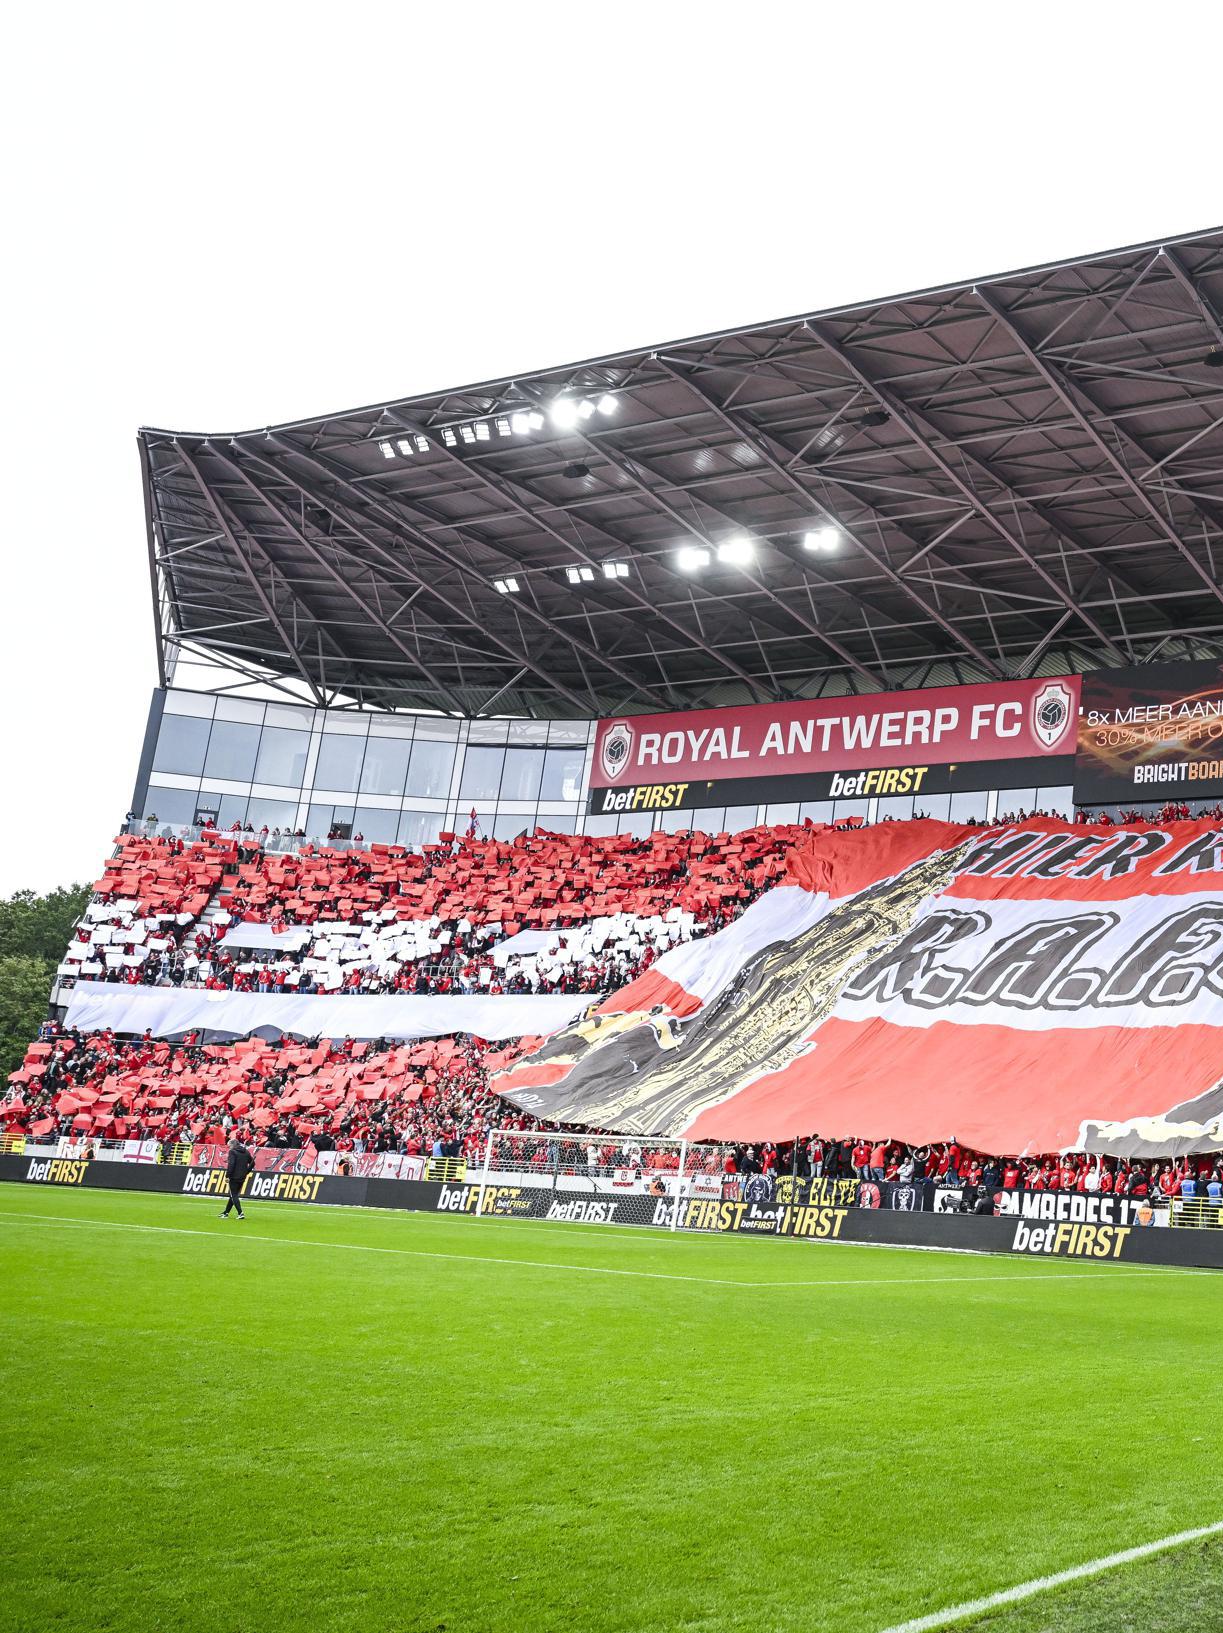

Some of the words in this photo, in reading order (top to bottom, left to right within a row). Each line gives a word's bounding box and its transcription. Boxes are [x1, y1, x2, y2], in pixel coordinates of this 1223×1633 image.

[1087, 710, 1110, 727] 8x
[1115, 704, 1172, 724] MEER
[637, 725, 750, 766] ROYAL
[758, 707, 959, 757] ANTWERP
[969, 701, 1023, 740] FC
[1095, 728, 1138, 747] 30%
[1143, 723, 1202, 743] MEER
[829, 766, 928, 797] betFIRST
[602, 784, 689, 811] betFIRST
[957, 828, 1172, 880] HIER
[26, 1158, 90, 1184] betFIRST
[250, 1173, 324, 1200] betFIRST
[546, 1199, 618, 1223] betFIRST
[741, 1218, 777, 1230] betFIRST
[1012, 1220, 1131, 1258] betFIRST
